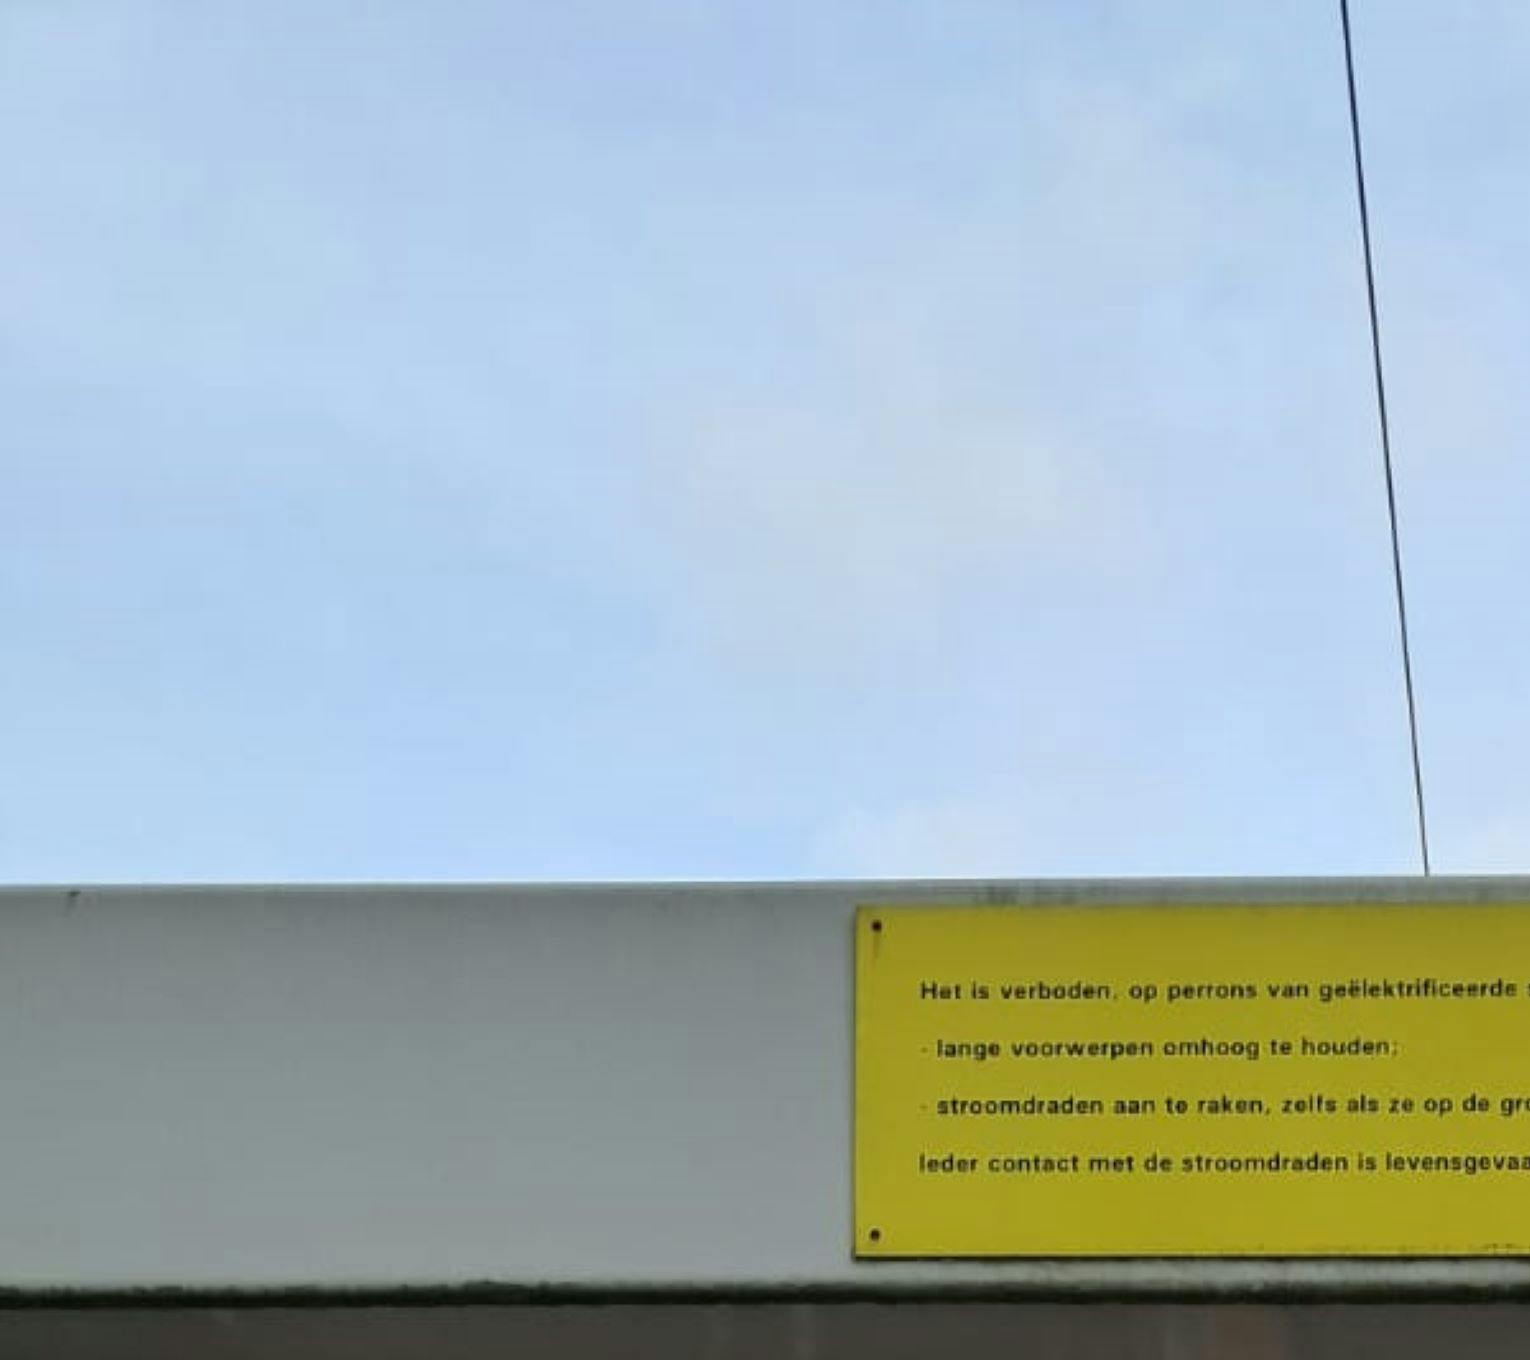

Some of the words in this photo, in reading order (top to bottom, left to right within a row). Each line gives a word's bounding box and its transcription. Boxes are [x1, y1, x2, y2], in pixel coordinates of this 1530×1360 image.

[920, 980, 961, 999] Het
[971, 981, 989, 999] is
[1129, 984, 1157, 1003] op
[1167, 984, 1257, 1003] perrons
[1267, 983, 1309, 999] van
[1319, 978, 1517, 1002] geëlektrificeerde
[937, 1040, 1000, 1060] lange
[1011, 1042, 1153, 1060] voorwerpen
[1162, 1038, 1260, 1060] omhoog
[1270, 1040, 1292, 1056] te
[936, 1095, 1104, 1115] stroomdraden
[1114, 1099, 1156, 1115] aan
[1165, 1097, 1188, 1114] te
[1197, 1094, 1271, 1117] raken,
[1281, 1094, 1337, 1113] zelfs
[1347, 1094, 1379, 1113] als
[1388, 1098, 1415, 1114] ze
[1424, 1098, 1453, 1117] op
[1462, 1093, 1490, 1113] de
[988, 1155, 1079, 1173] contact
[1088, 1156, 1134, 1173] met
[1143, 1152, 1172, 1173] de
[1182, 1152, 1348, 1173] stroomdraden
[1357, 1152, 1377, 1171] is
